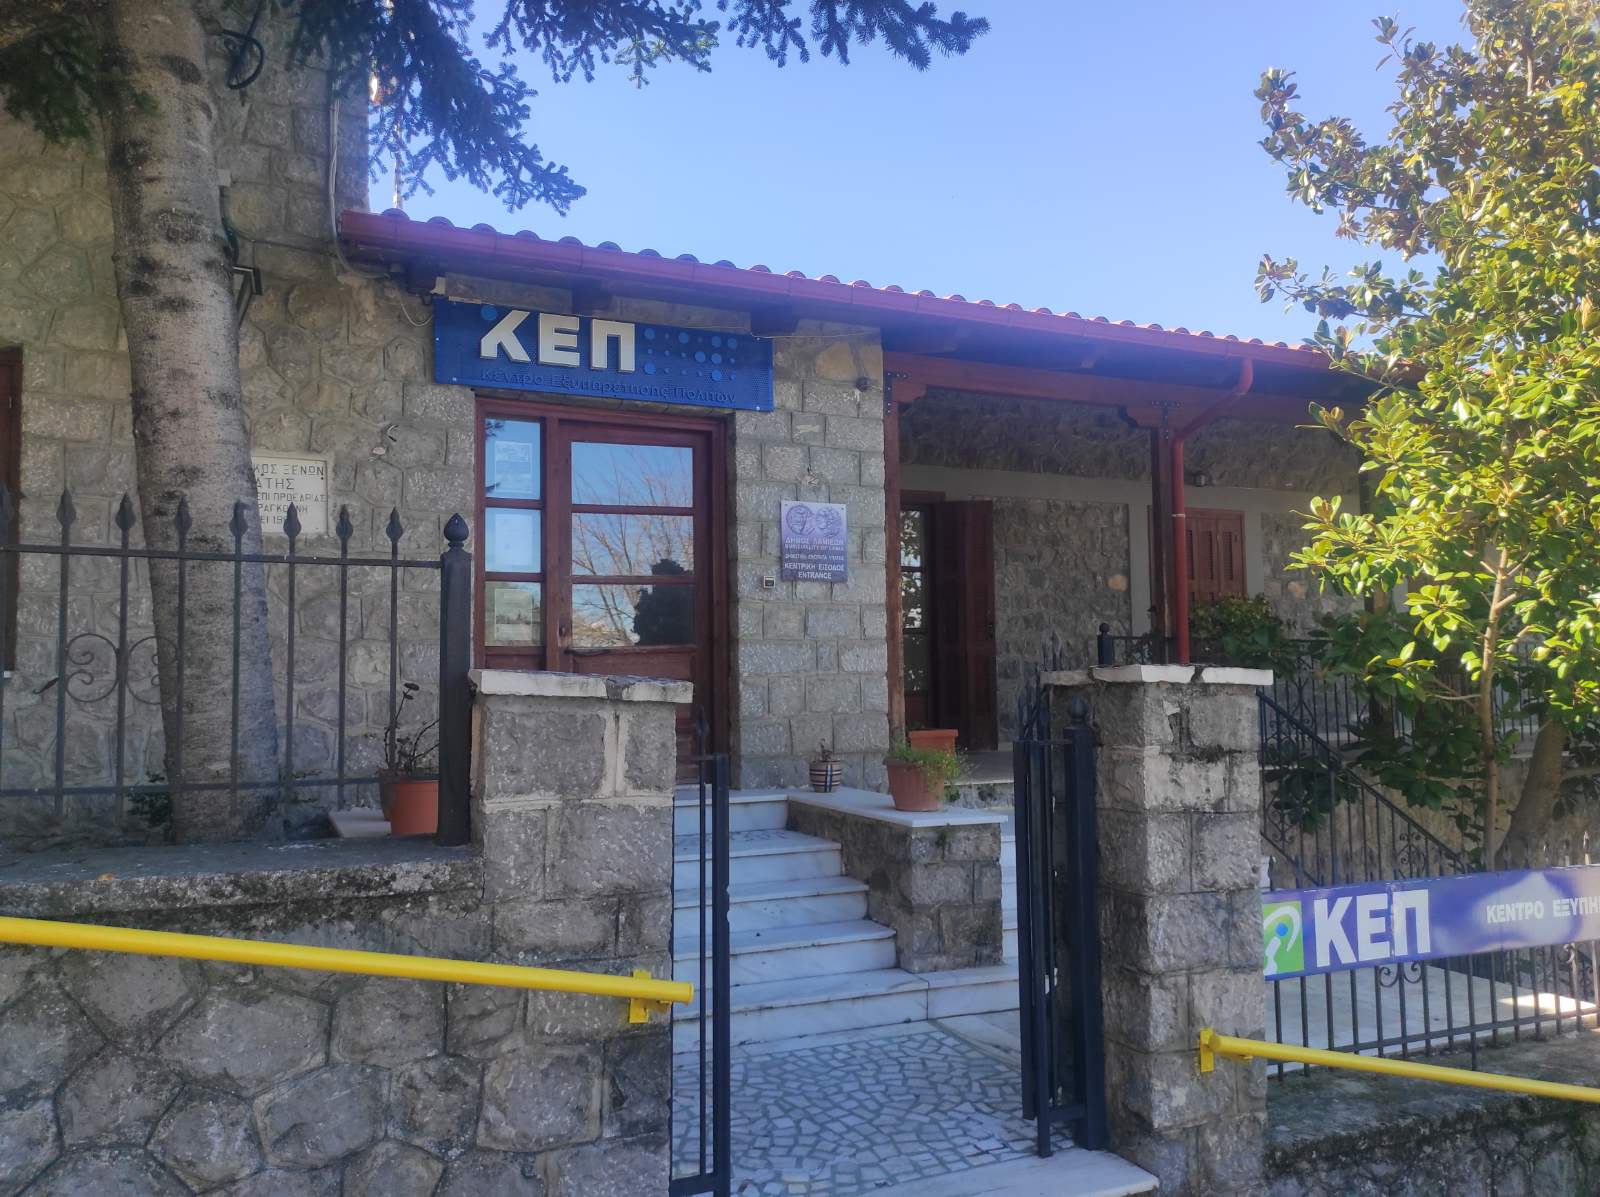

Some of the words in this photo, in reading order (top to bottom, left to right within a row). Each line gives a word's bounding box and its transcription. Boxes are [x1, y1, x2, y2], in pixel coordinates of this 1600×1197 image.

[480, 309, 636, 373] ΚΕΠ
[798, 571, 832, 579] ENTRANCE
[1313, 889, 1431, 967] ΚΕΠ
[1486, 900, 1545, 923] ΚΕΝΤΡΟ
[1552, 896, 1600, 917] ΕΞΥΠΗ
